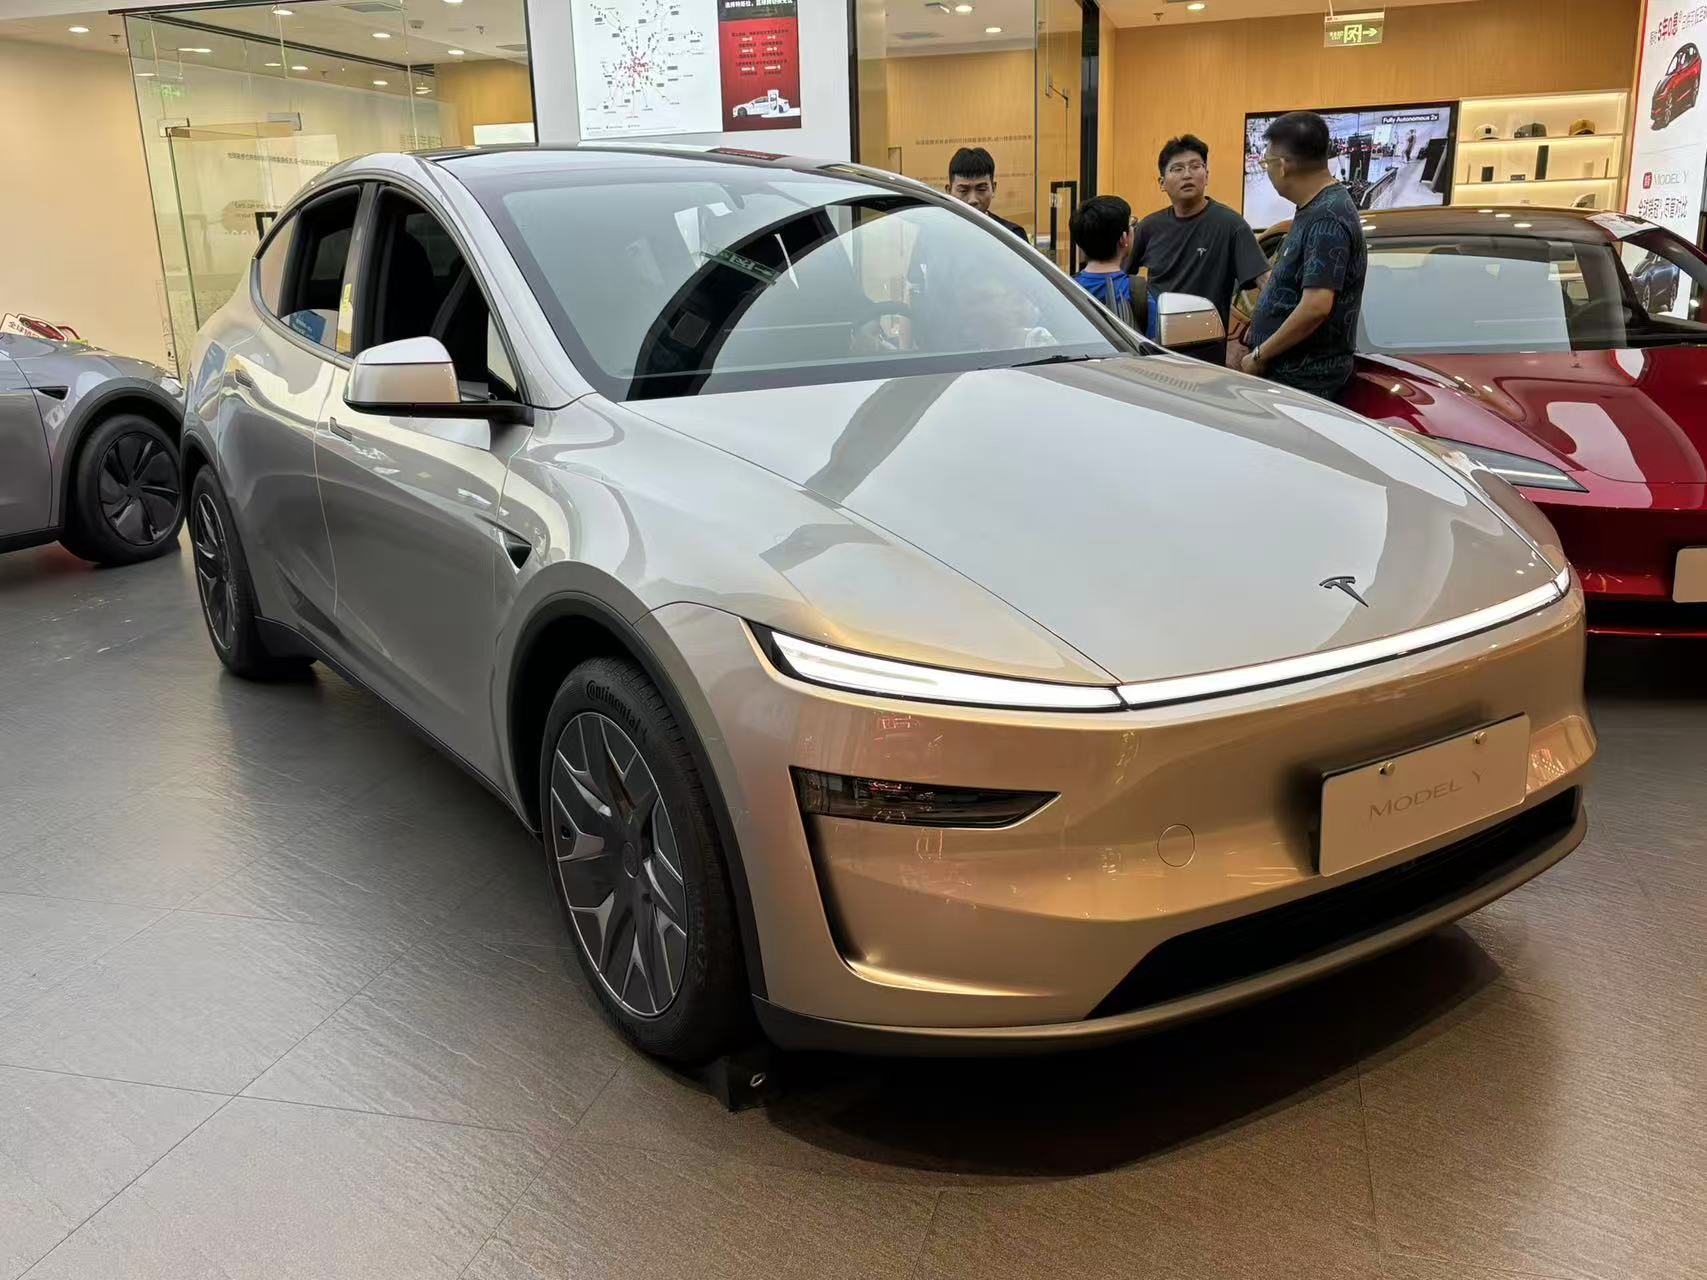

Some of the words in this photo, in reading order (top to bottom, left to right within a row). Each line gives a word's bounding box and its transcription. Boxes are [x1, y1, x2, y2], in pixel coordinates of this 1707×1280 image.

[1396, 115, 1430, 123] Autonomous
[1654, 172, 1680, 186] MODEL
[586, 679, 641, 735] Continental
[1368, 779, 1462, 821] MODEL
[1471, 767, 1488, 785] Y
